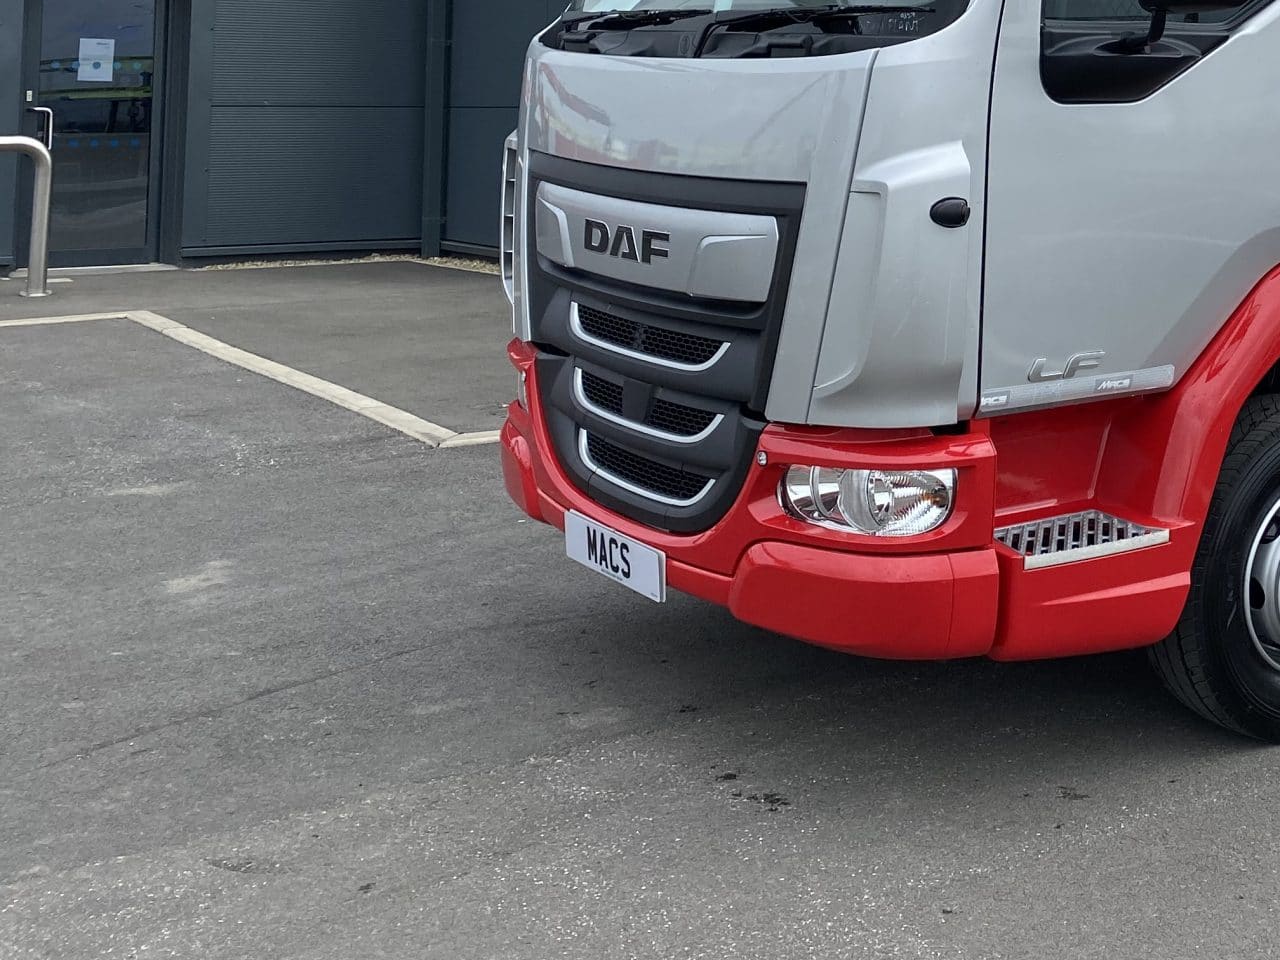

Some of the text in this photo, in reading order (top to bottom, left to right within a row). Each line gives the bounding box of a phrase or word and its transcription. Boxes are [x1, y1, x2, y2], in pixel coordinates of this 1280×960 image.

[584, 217, 671, 265] DAF
[1027, 350, 1106, 383] LF
[586, 525, 631, 580] MACS
